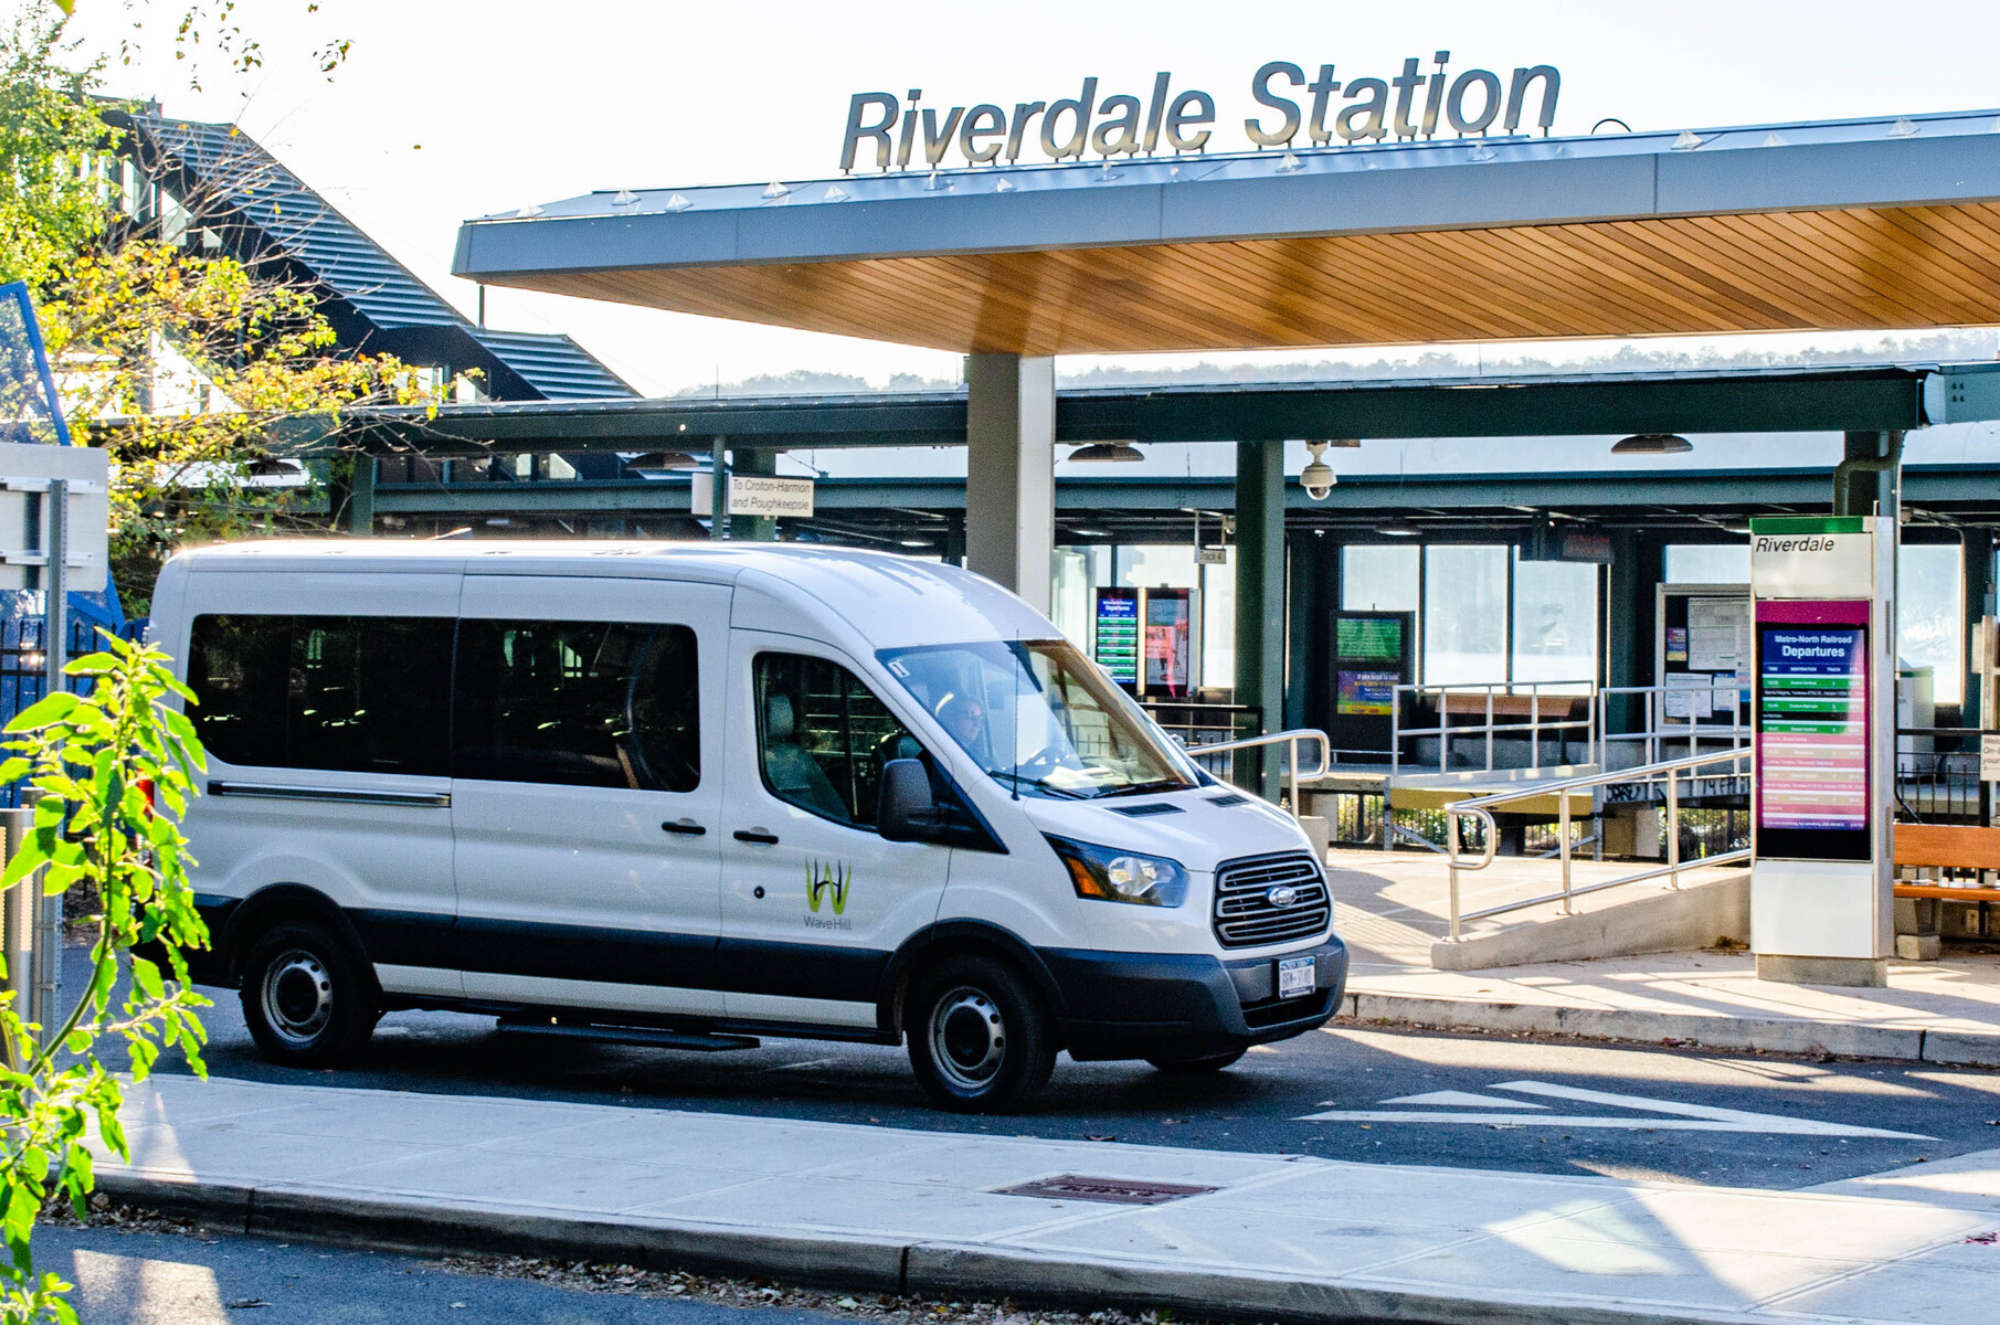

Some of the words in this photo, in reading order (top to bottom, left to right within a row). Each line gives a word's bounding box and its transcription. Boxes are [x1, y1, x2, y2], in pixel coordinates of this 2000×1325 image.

[839, 72, 1216, 170] Riverdale
[1244, 50, 1561, 146] Station
[733, 479, 742, 490] To
[745, 480, 810, 493] Croton-Harmon
[732, 498, 749, 508] and
[751, 496, 809, 511] Poughkeepsie
[1756, 537, 1834, 552] Riverdale
[1774, 635, 1819, 643] Metro-North
[1820, 635, 1852, 643] Railroad
[1782, 645, 1845, 659] Departures
